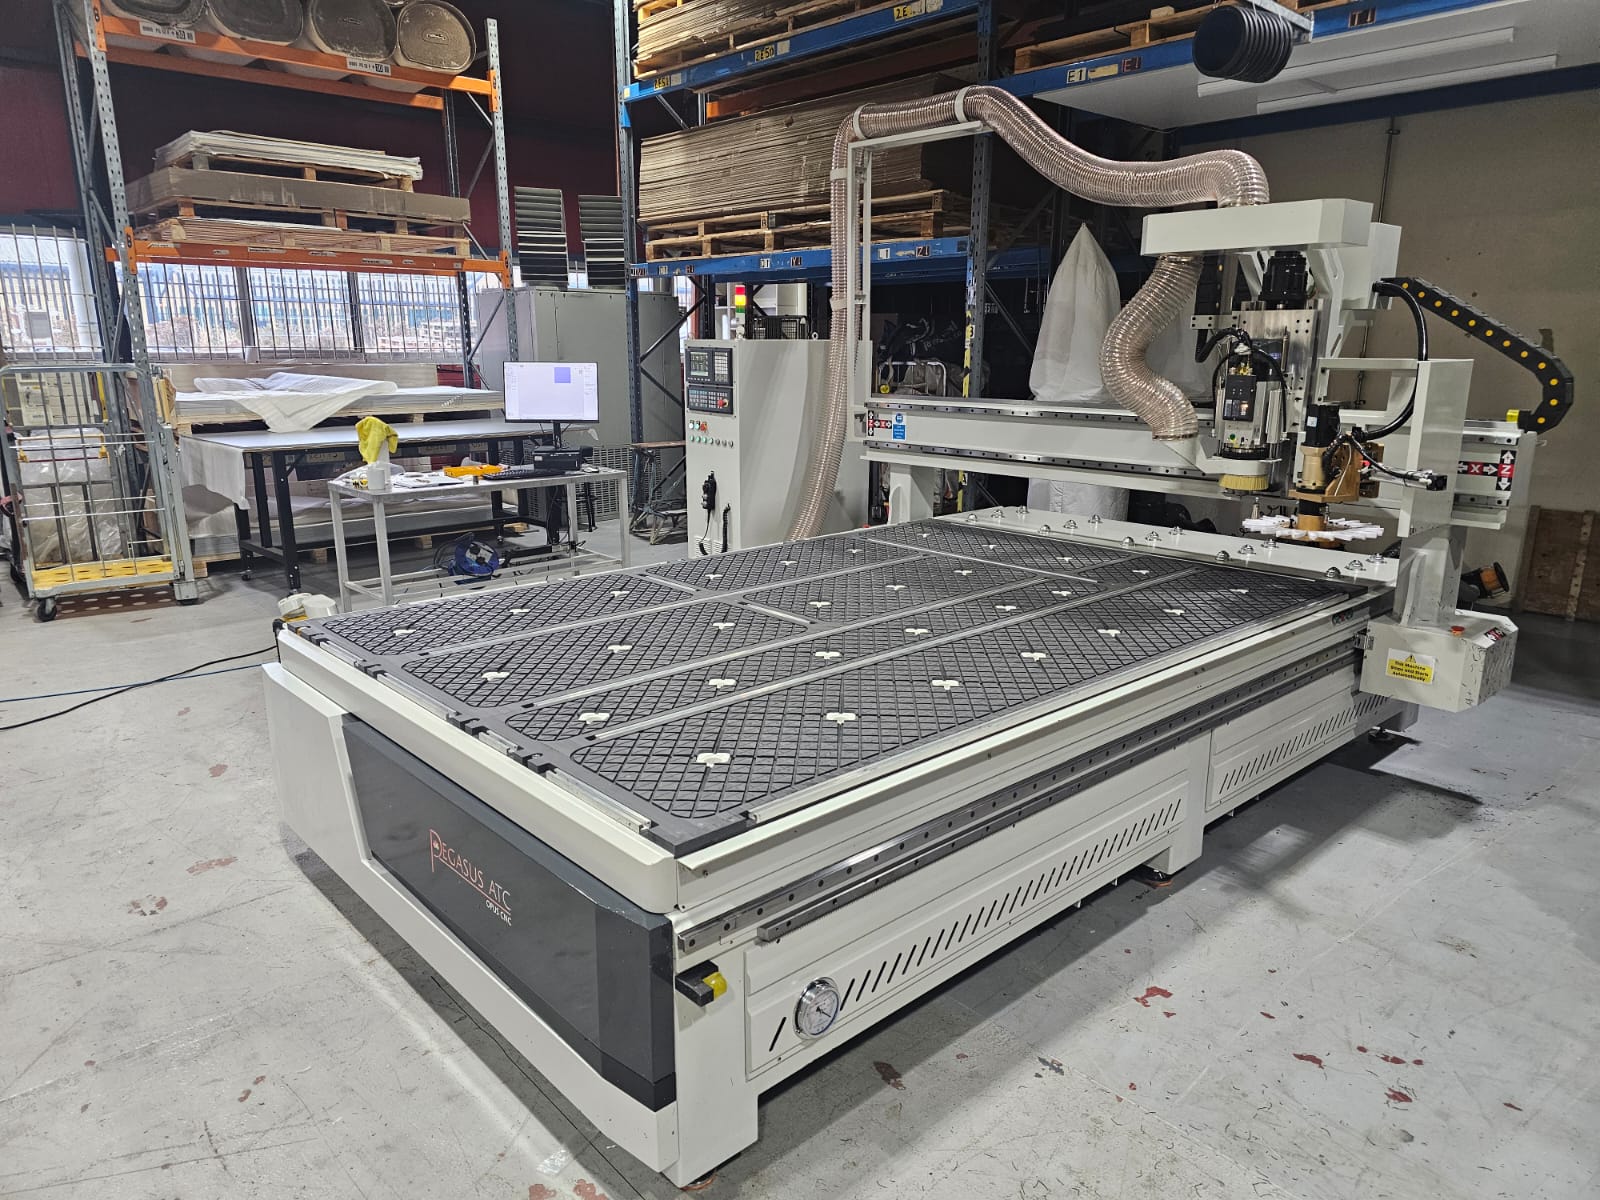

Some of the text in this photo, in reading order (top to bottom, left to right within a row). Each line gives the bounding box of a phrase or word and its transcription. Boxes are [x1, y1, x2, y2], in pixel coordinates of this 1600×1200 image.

[1470, 464, 1481, 473] X
[1500, 465, 1511, 475] Z
[429, 829, 511, 911] PEGASUS ATC
[486, 899, 512, 927] OPUS CNC
